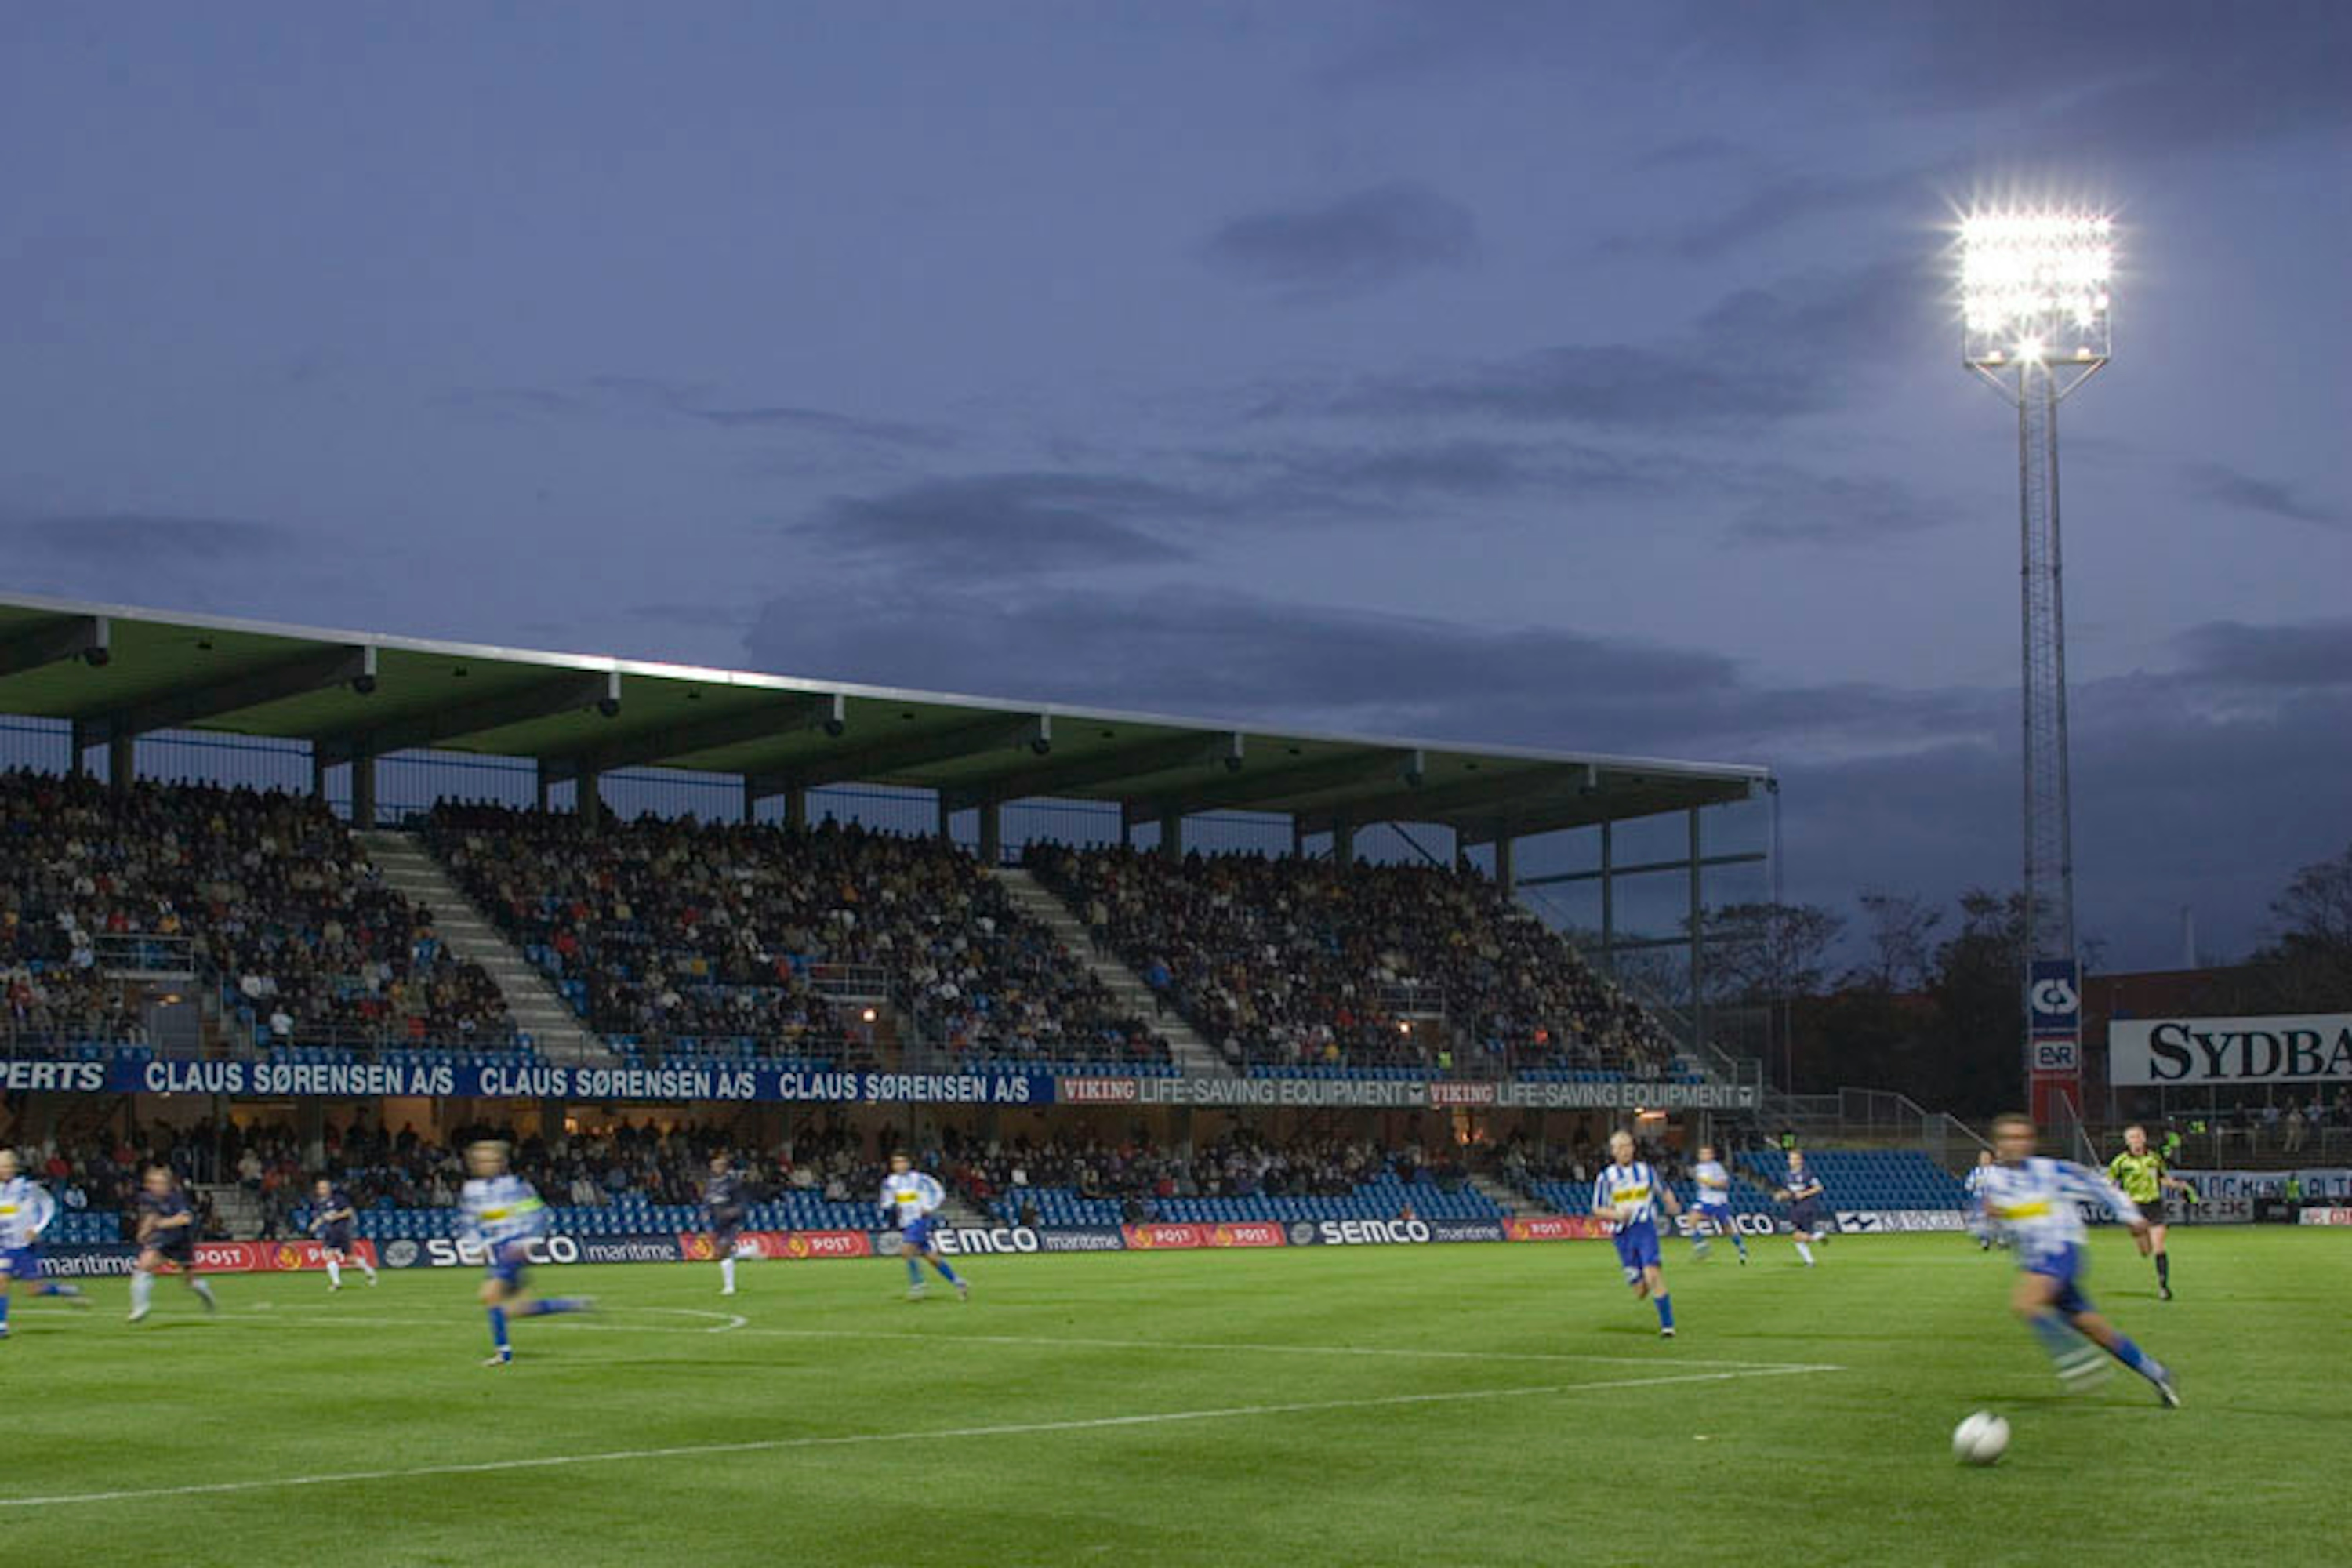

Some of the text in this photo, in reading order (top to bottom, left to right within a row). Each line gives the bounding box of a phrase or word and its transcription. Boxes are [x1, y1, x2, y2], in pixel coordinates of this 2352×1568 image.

[2149, 1022, 2352, 1080] SYDBA
[146, 1062, 454, 1094] CLAUS SØRENSEN A/S
[479, 1067, 756, 1098] CLAUS SØRENSEN A/S
[779, 1073, 1030, 1102] CLAUS SØRENSEN A/S
[1064, 1078, 1404, 1105] VIKING LIFE-SAVING EQUIPMENT
[1430, 1082, 1736, 1107] VIKING LIFE-SAVING EQUIPMENT
[812, 1238, 851, 1253] POST
[1046, 1231, 1120, 1251] maritime
[1320, 1220, 1430, 1245] SEMCO
[588, 1240, 675, 1261] maritime
